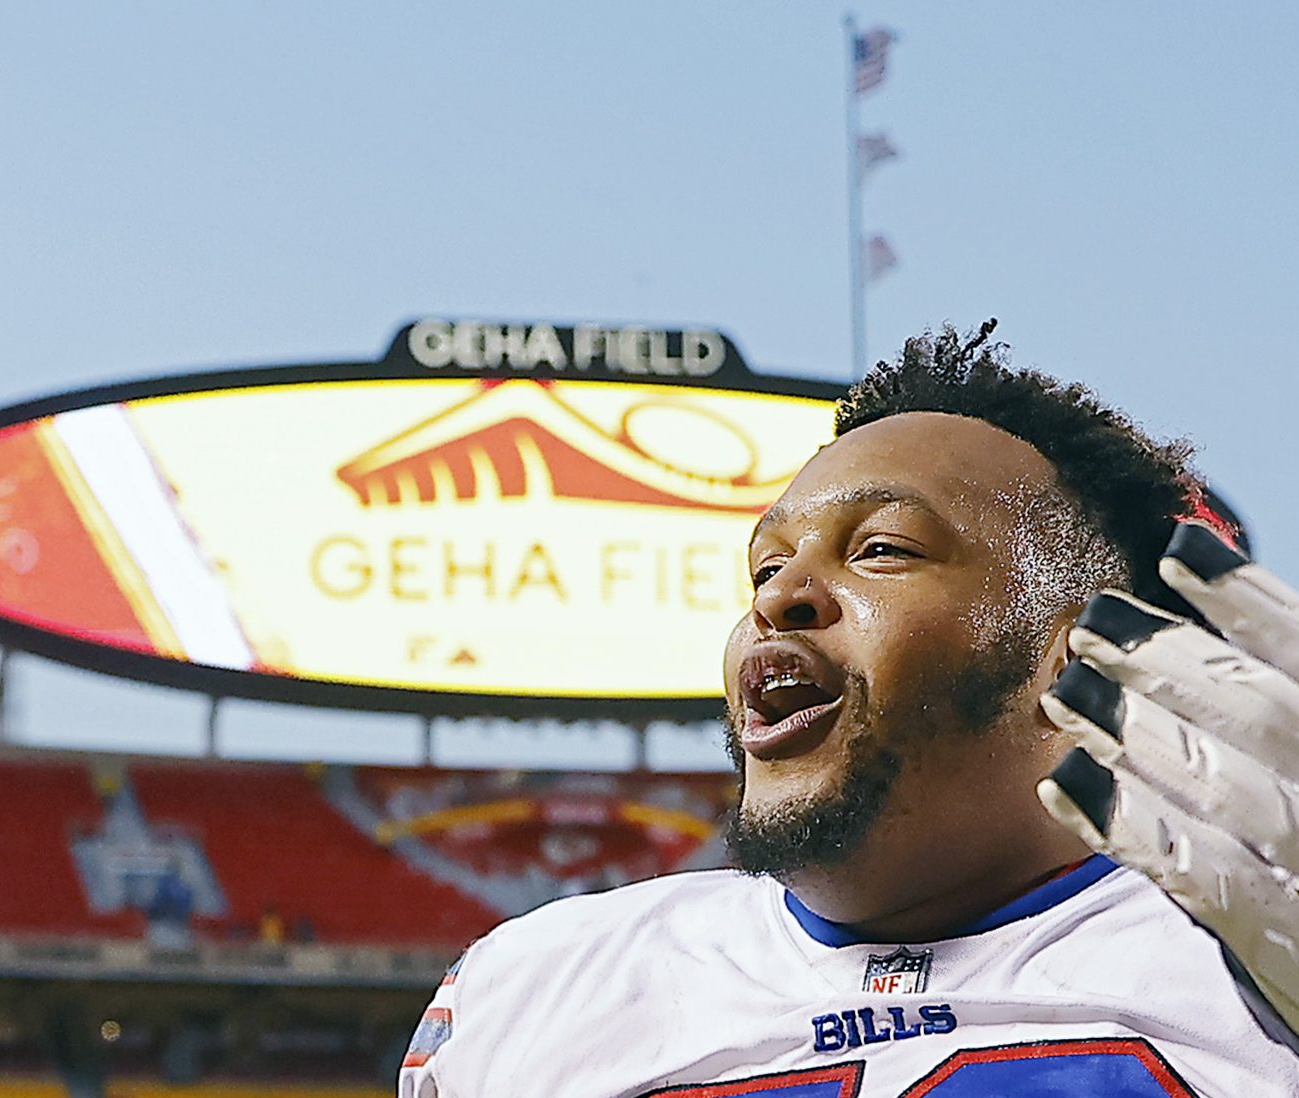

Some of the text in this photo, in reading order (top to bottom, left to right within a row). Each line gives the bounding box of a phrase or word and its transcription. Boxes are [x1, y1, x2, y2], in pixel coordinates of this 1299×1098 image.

[407, 319, 726, 376] GEHA FIELD
[310, 535, 751, 613] GEHA FIEL
[812, 1004, 957, 1052] BILLS
